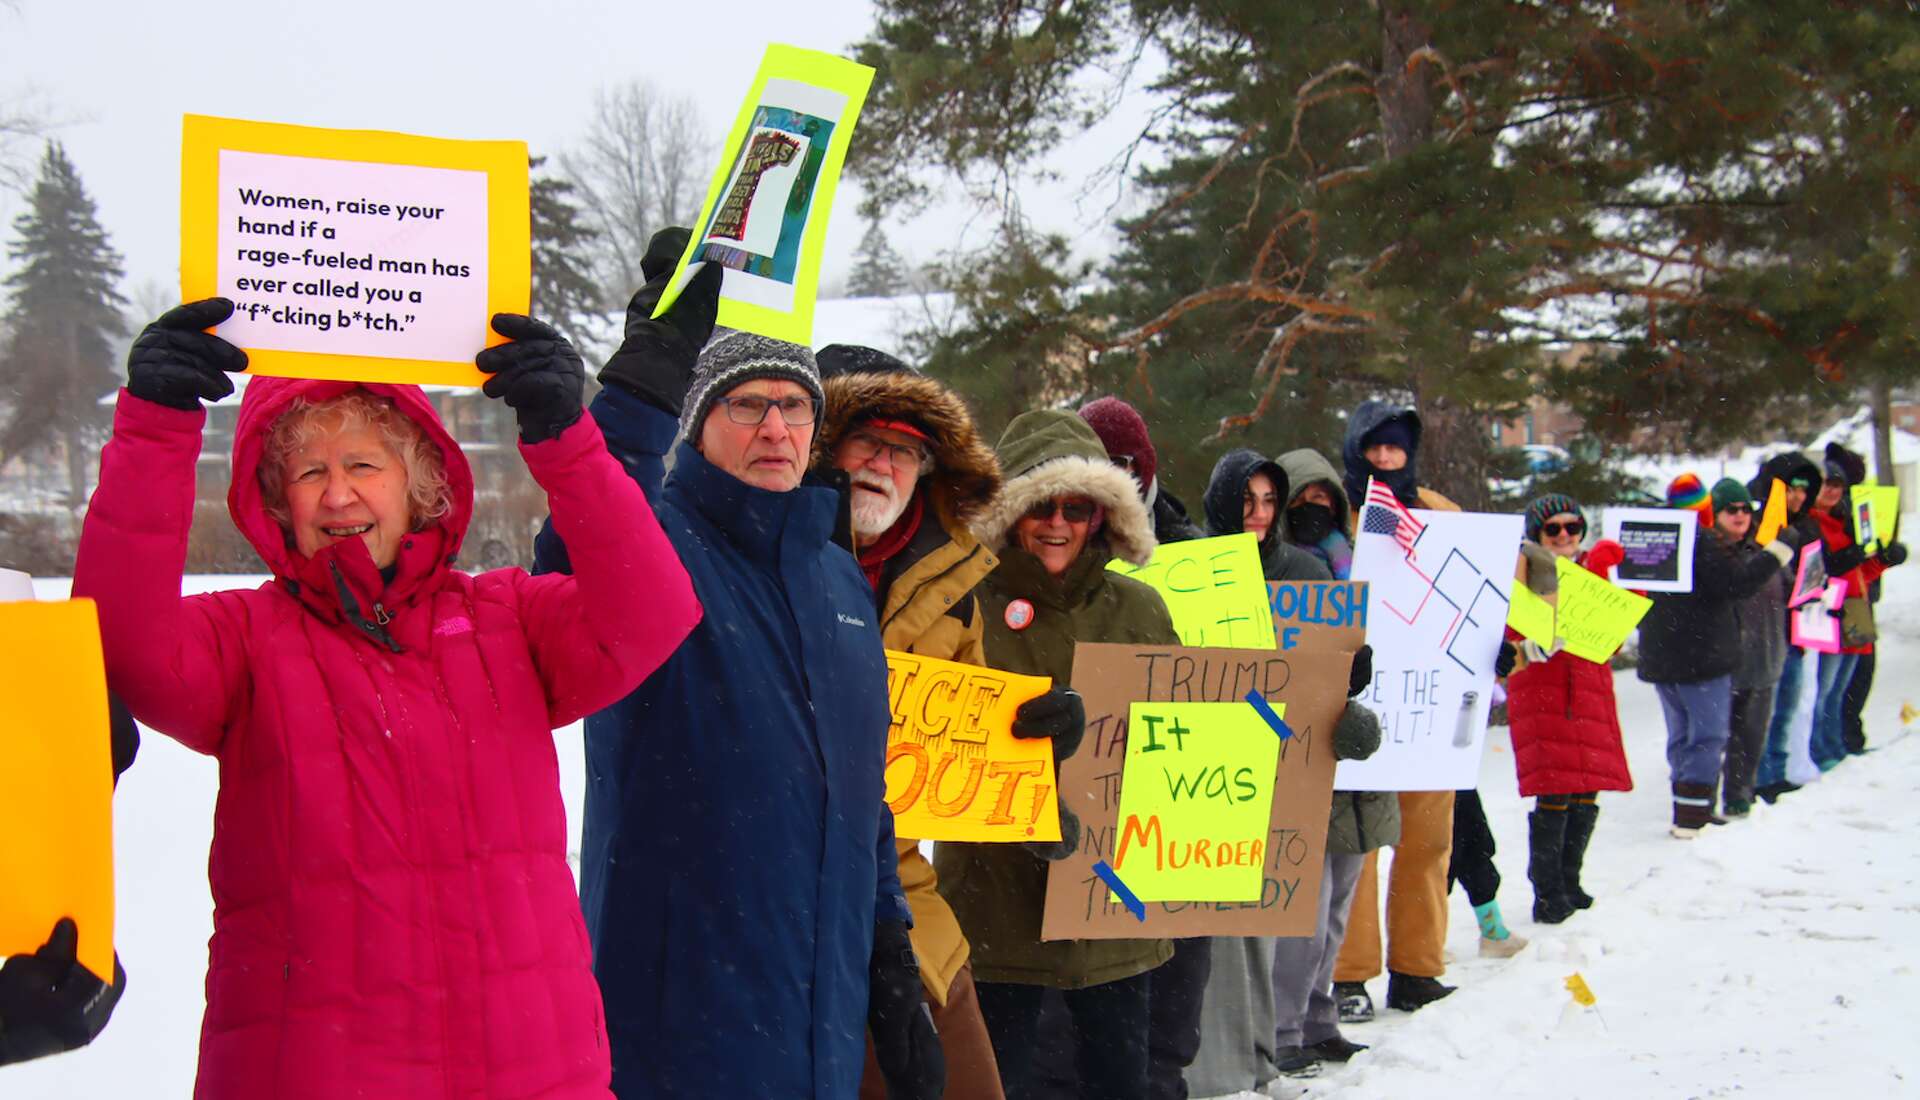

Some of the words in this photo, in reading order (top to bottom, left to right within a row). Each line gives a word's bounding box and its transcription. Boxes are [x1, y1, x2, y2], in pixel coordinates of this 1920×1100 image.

[239, 188, 330, 214] Women,
[337, 198, 390, 215] raise
[396, 206, 444, 221] your
[239, 216, 294, 236] hand
[301, 221, 317, 237] if
[322, 228, 335, 239] a
[238, 249, 372, 270] rage-fueled
[379, 260, 426, 274] man
[433, 258, 469, 277] has
[237, 278, 287, 293] ever
[293, 279, 358, 298] called
[365, 288, 403, 304] you
[409, 291, 421, 303] a
[1267, 584, 1369, 627] OLISH
[1136, 654, 1291, 703] TRUMP
[1402, 669, 1440, 706] THE
[887, 657, 1006, 745] ICE
[1141, 714, 1191, 753] It
[1380, 708, 1434, 744] ALT!
[886, 742, 1051, 837] OUT!
[1271, 829, 1308, 872] TO
